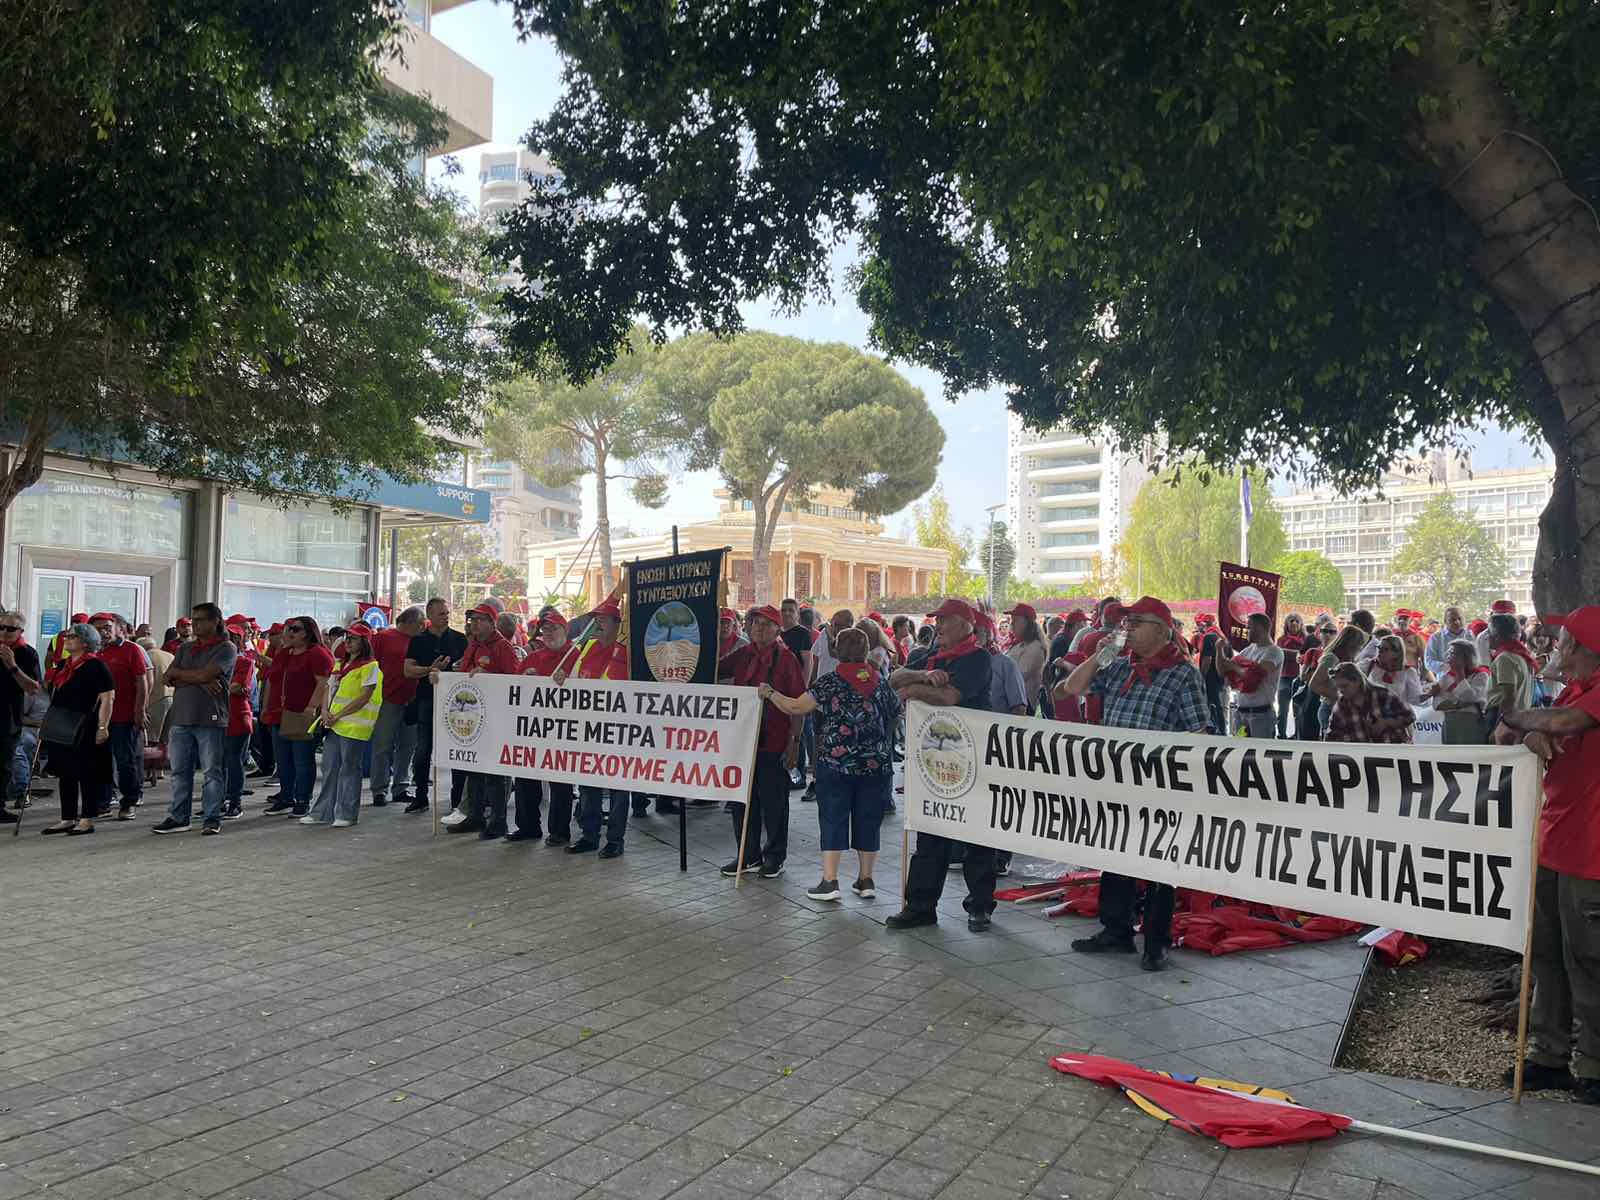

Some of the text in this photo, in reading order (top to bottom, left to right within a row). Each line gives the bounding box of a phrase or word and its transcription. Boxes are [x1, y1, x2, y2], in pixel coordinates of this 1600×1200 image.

[437, 486, 475, 502] SUPPORT
[637, 560, 711, 585] ΕΝΩΣΗ ΚΥΠΡΙΩΝ
[637, 580, 711, 605] ΣΥΝΤΑΞΙΟΥΧΩΝ
[508, 686, 738, 721] Η ΑΚΡΙΒΕΙΑ ΤΣΑΚΙΖΕΙ
[517, 716, 721, 753] ΠΑΡΤΕ ΜΕΤΡΑ ΤΩΡΑ
[449, 748, 478, 765] Ε.ΚΥ.ΣΥ.
[499, 745, 742, 789] ΔΕΝ ΑΝΤΕΧΟΥΜΕ ΑΛΛΟ
[985, 723, 1513, 829] ΑΠΑΙΤΟΥΜΕ ΚΑΤΑΡΓΗΣΗ
[922, 800, 967, 824] Ε.ΚΥ.ΣΥ.
[988, 783, 1512, 920] ΤΟΥ ΠΕΝΑΛΤΙ 12% ΑΠΟ ΤΙΣ ΣΥΝΤΑΞΕΙΣ
